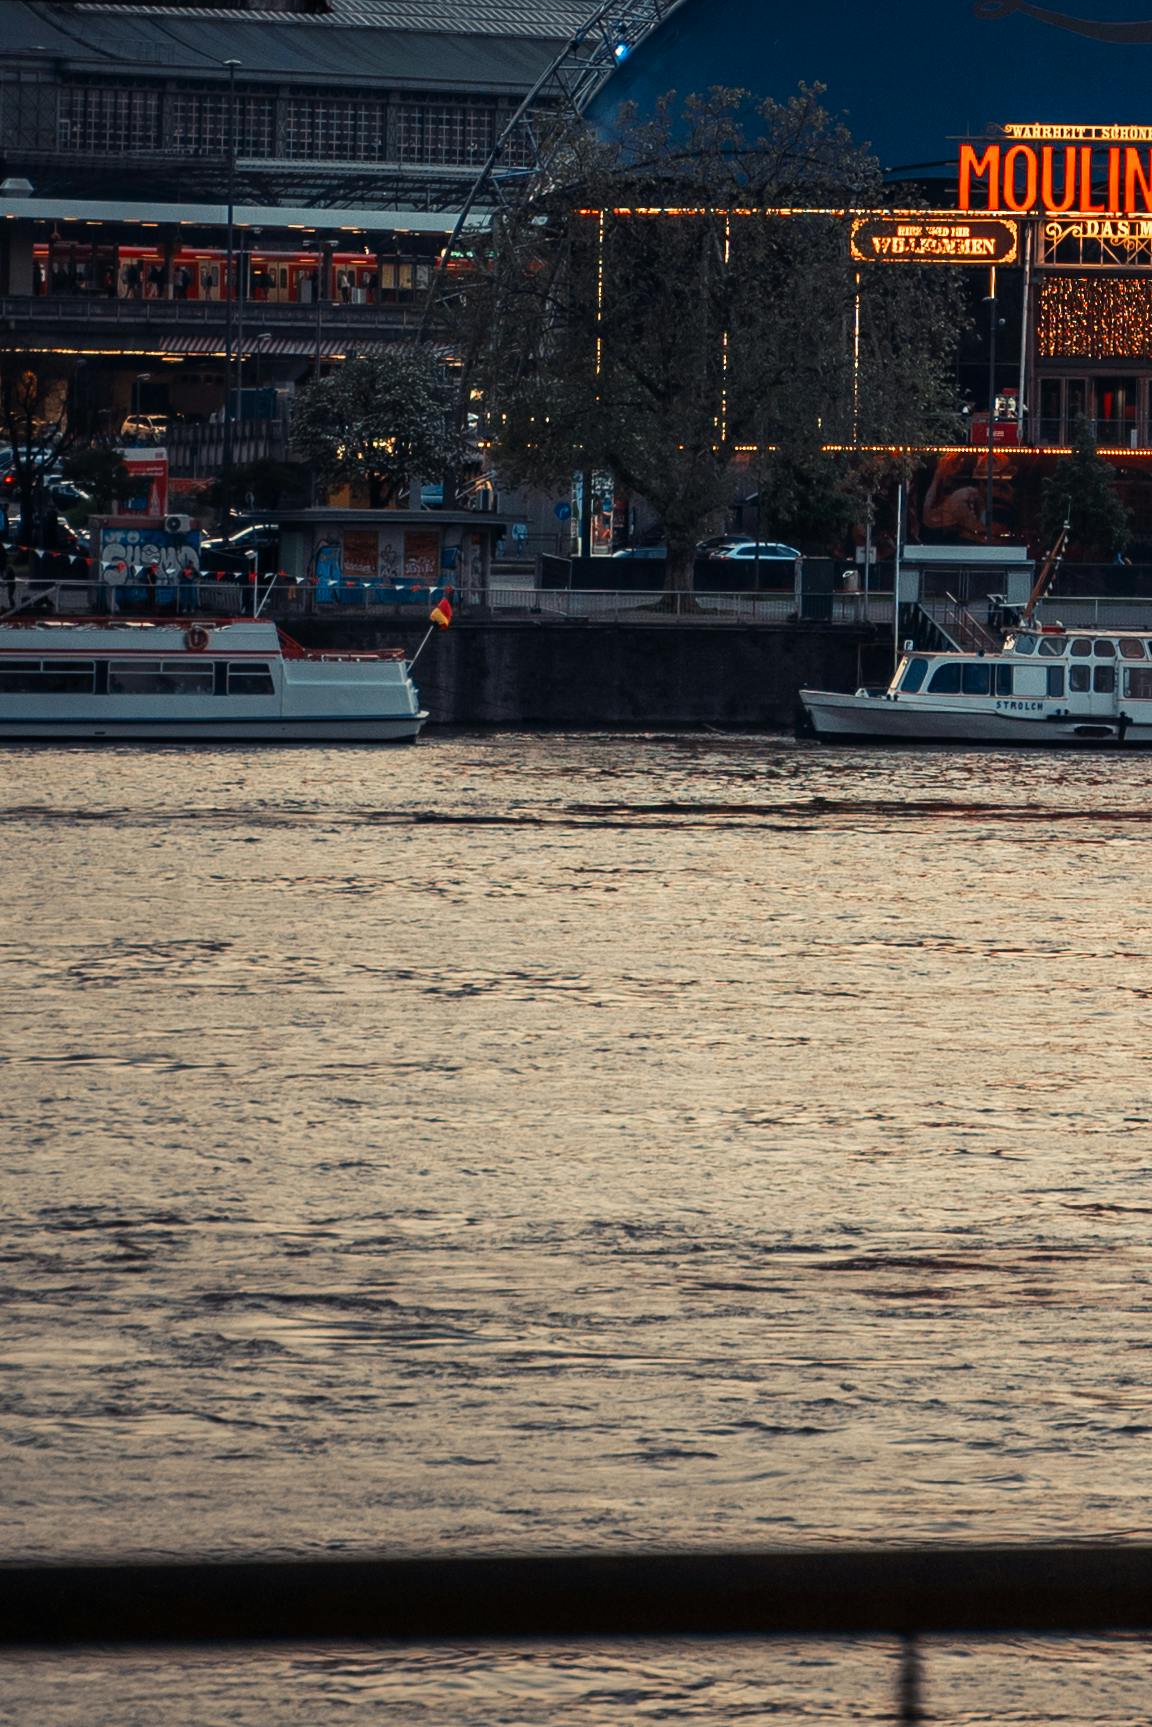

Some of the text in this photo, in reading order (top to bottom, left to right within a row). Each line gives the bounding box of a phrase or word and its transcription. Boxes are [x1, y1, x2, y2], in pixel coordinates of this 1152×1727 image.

[1013, 125, 1085, 139] WAHRHEIT
[1087, 221, 1129, 238] DAS
[996, 700, 1044, 712] STROLCH
